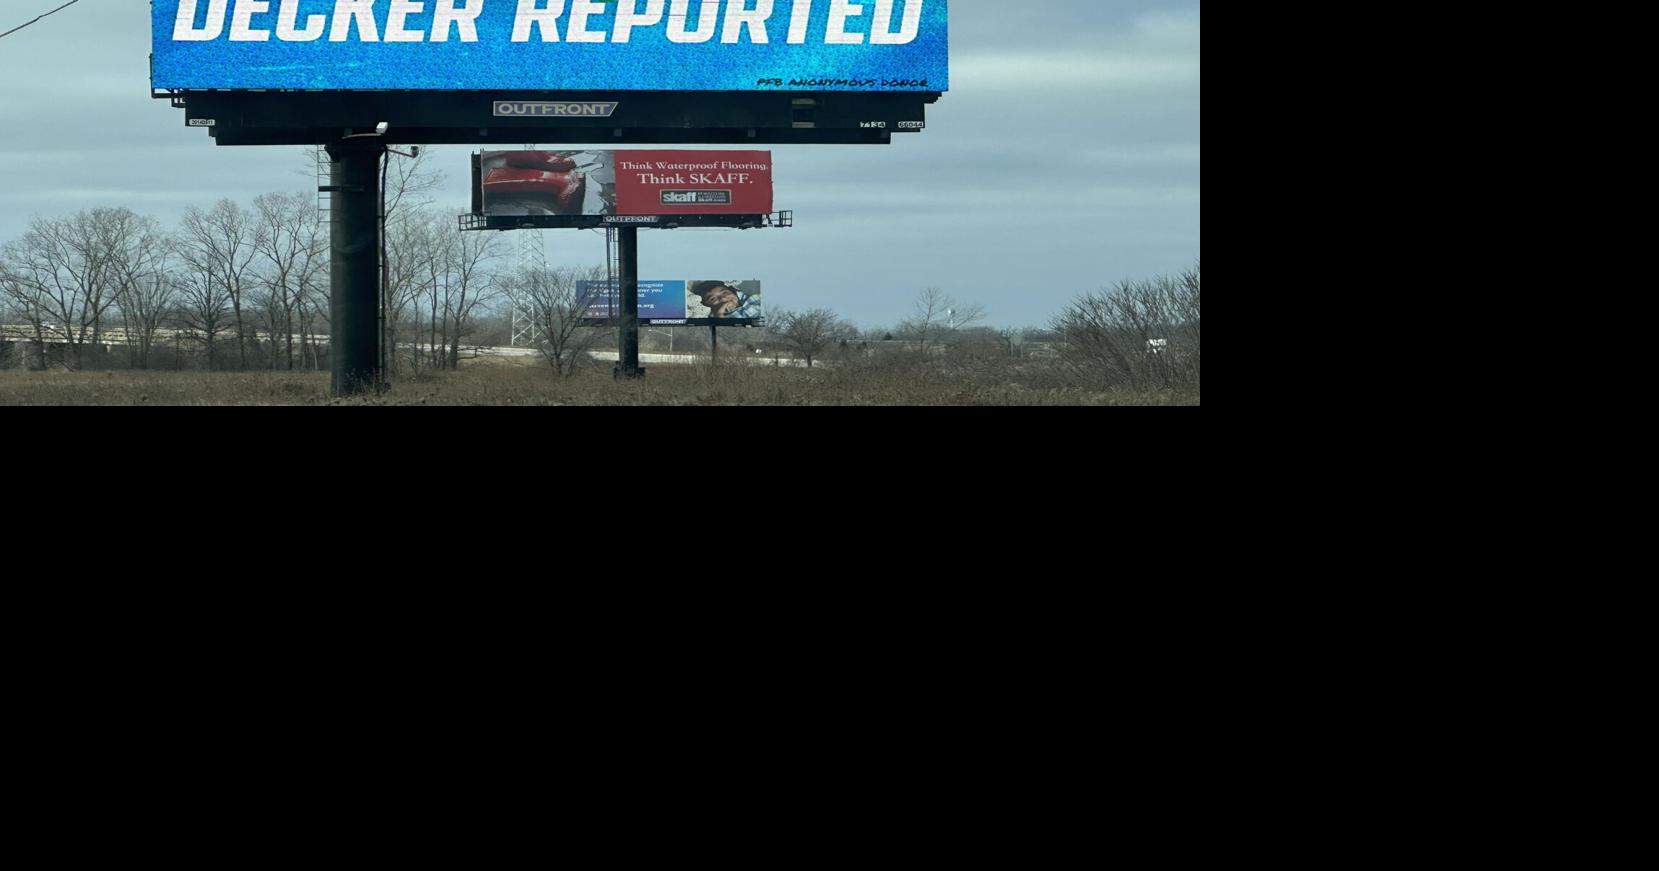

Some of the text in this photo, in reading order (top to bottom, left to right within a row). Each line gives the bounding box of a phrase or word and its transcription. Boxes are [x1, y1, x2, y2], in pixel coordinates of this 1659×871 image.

[172, 0, 922, 45] DECKER REPORTED
[787, 78, 876, 87] ANONYMOUS
[880, 78, 929, 87] DONOR
[498, 103, 611, 116] OUTFRONT
[620, 161, 769, 171] Think Waterproof Flooring.
[637, 173, 753, 184] Think SKAFF.
[662, 191, 697, 202] skaff
